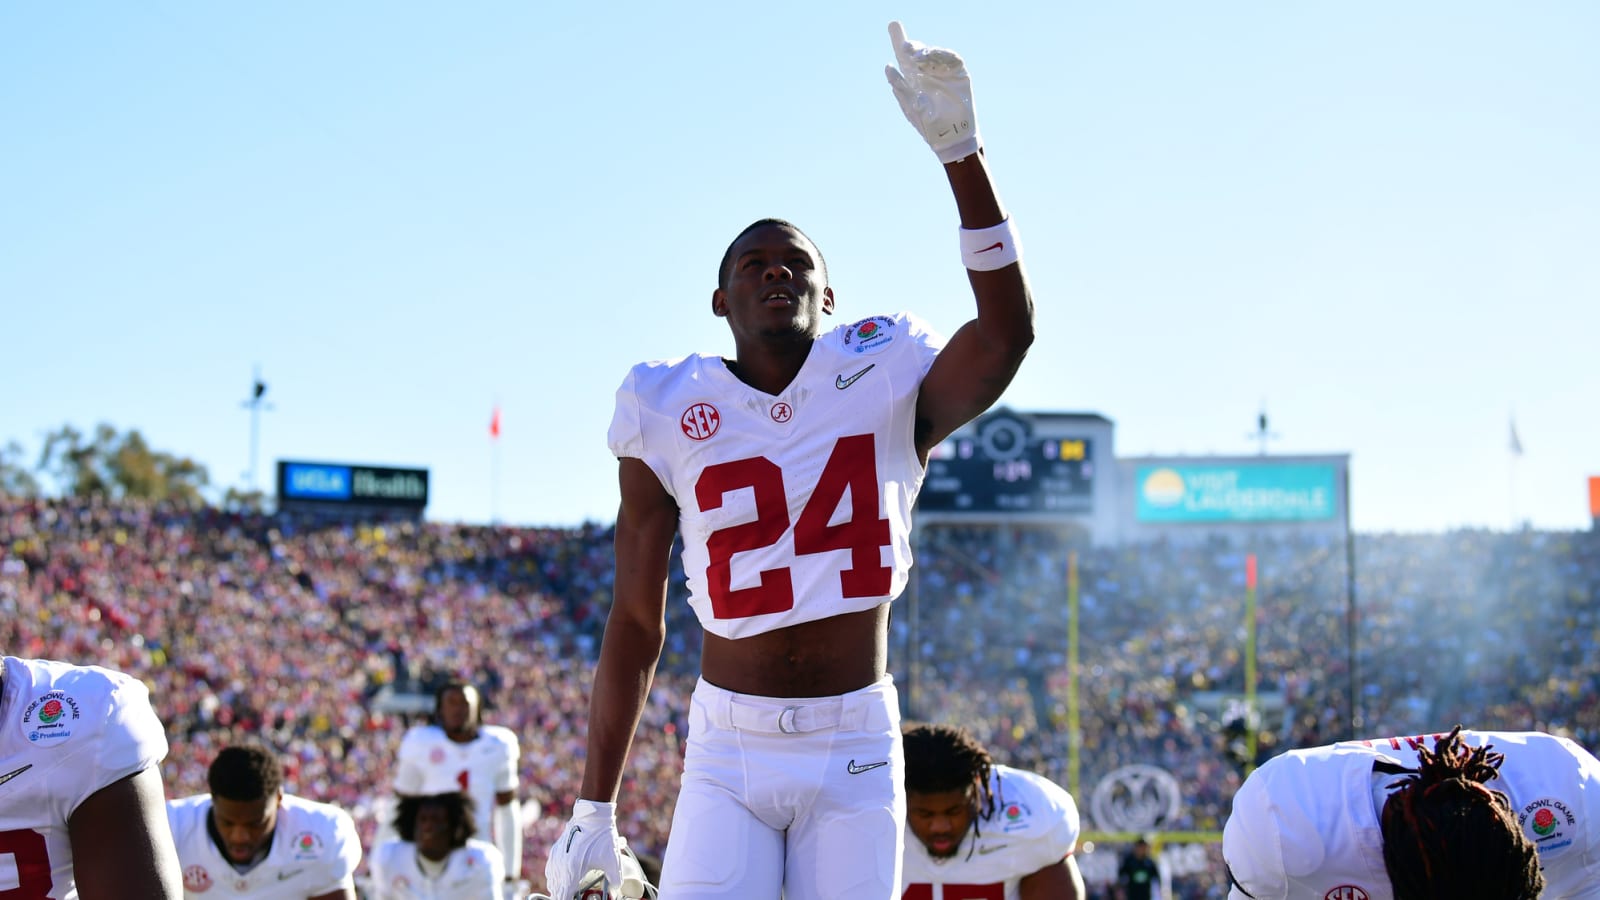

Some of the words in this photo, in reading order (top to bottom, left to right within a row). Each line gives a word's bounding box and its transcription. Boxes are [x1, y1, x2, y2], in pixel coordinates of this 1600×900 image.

[863, 335, 893, 351] Prudential
[681, 403, 720, 440] SEC
[353, 470, 425, 497] Health
[694, 432, 893, 620] 24
[23, 700, 39, 723] ROSE
[40, 692, 65, 703] BOWL
[65, 697, 80, 720] GAME
[40, 730, 71, 740] Prudential
[1525, 799, 1552, 814] BOWL
[1554, 801, 1575, 826] GAME
